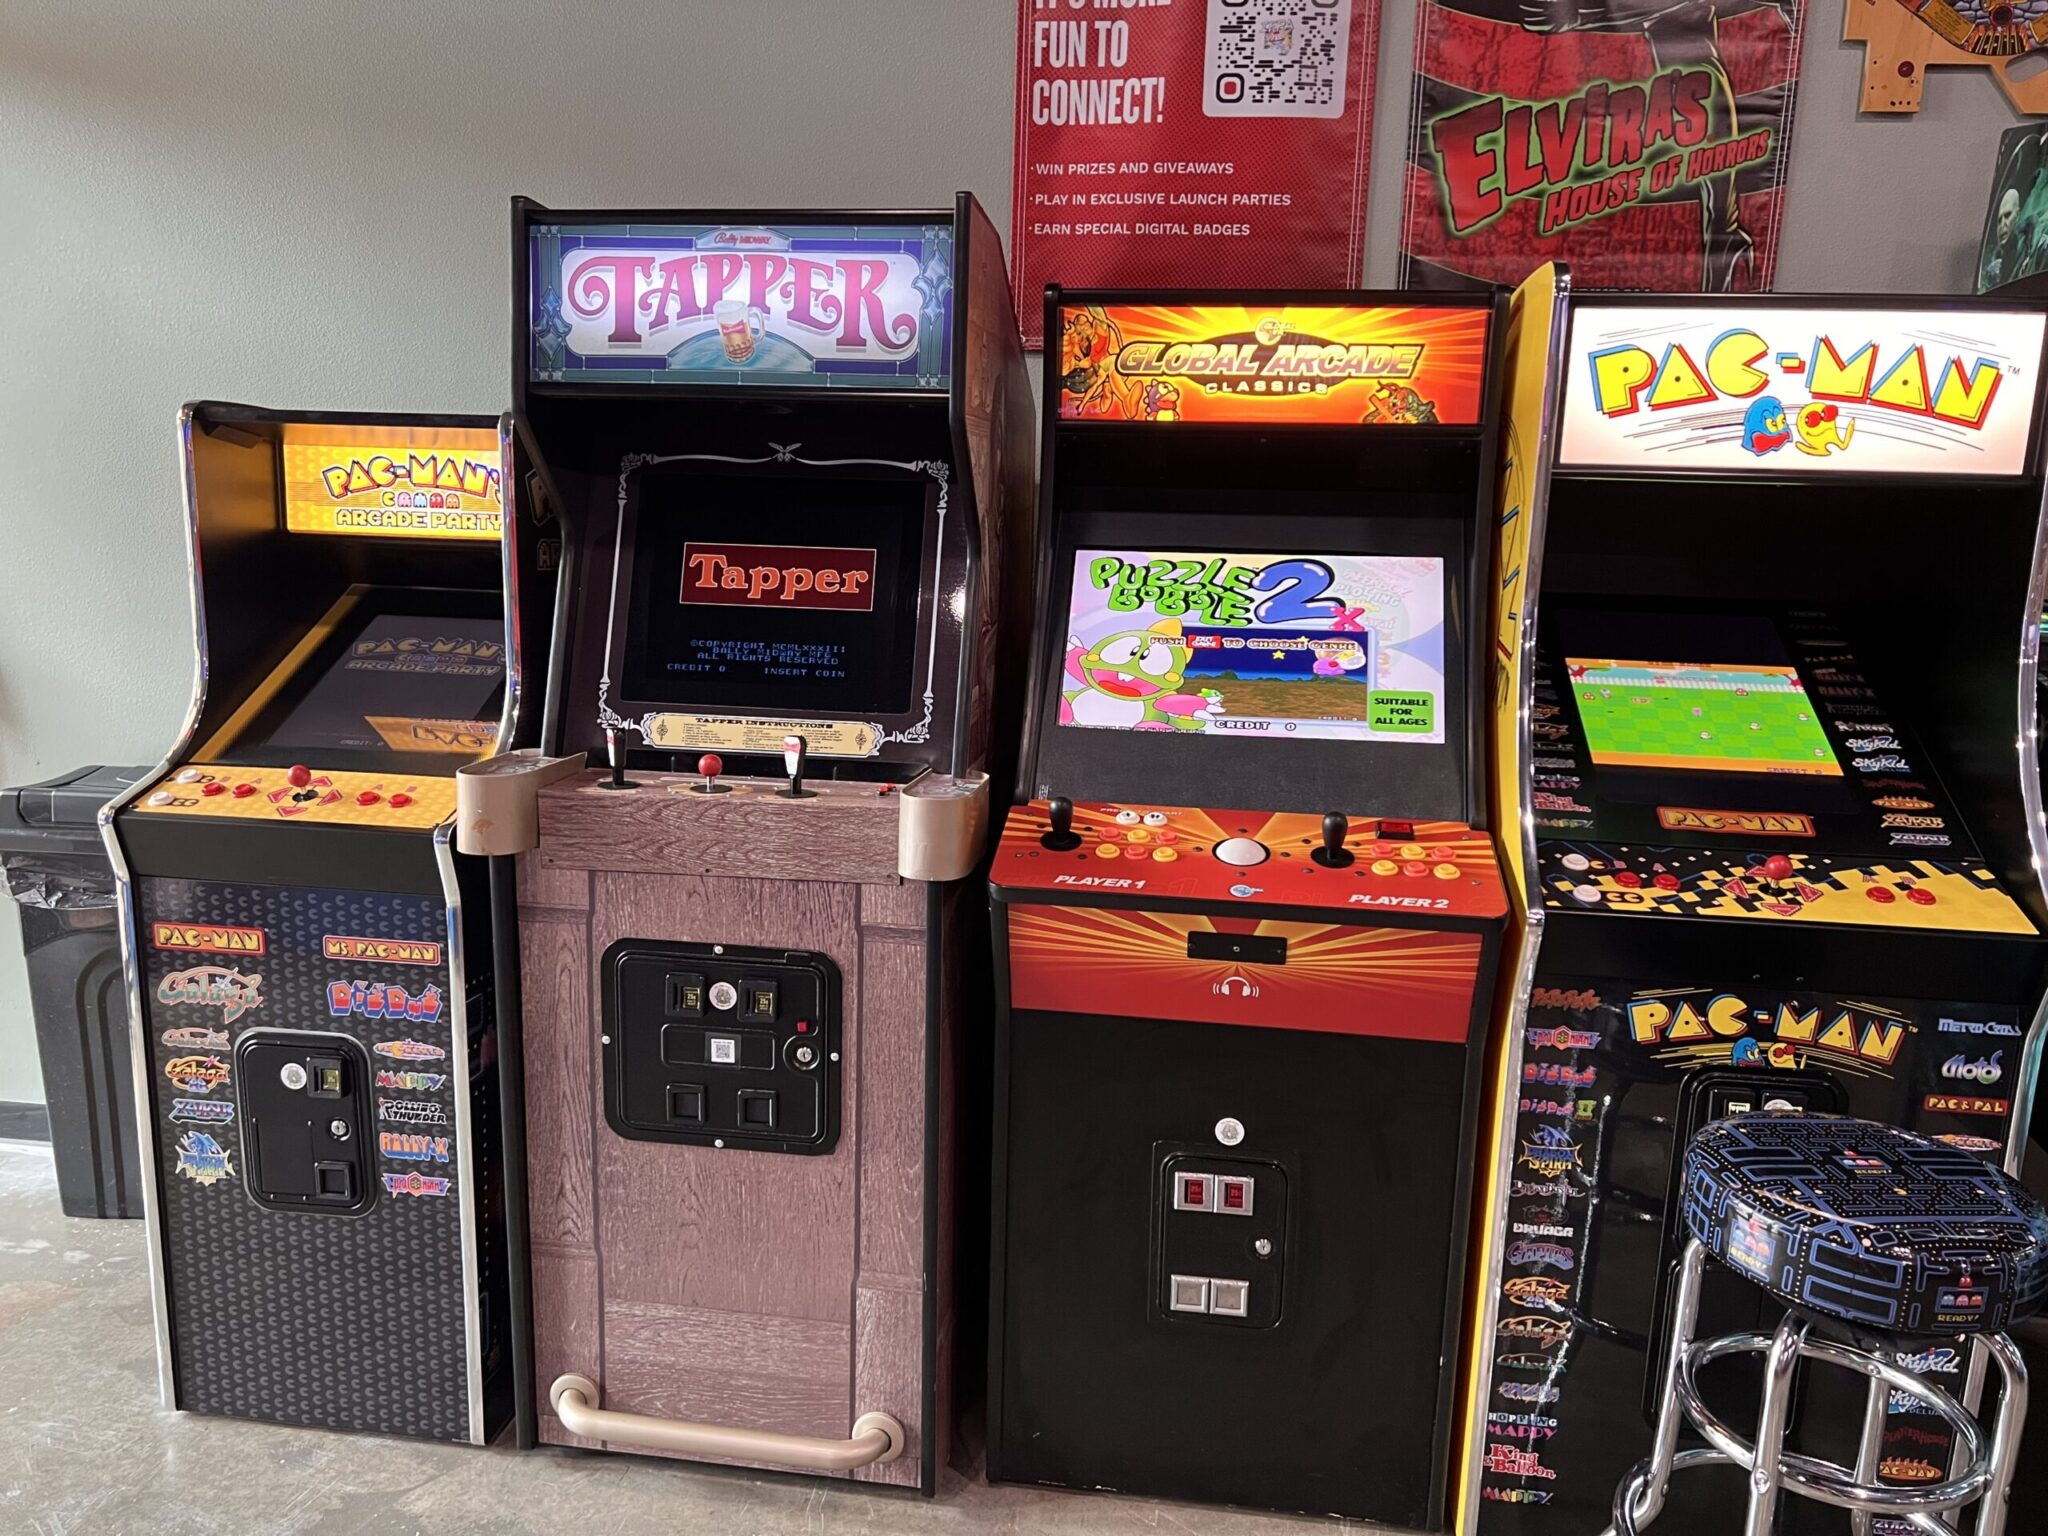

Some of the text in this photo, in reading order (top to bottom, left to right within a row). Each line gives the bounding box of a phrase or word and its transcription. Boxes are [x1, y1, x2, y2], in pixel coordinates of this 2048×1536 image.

[1034, 20, 1128, 67] FUN TO
[1032, 77, 1166, 126] CONNECT!
[1433, 69, 1713, 233] ELVIRA'S
[1036, 162, 1235, 175] WIN PRIZES AND GIVEAWAYS
[1543, 130, 1772, 234] HOUSE OF HORRORS
[1035, 193, 1291, 206] PLAY IN EXCLUSIVE LAUNCH PARTIES
[1034, 223, 1251, 236] EARN SPECIAL DIGITAL BADGES
[567, 253, 918, 350] TAPPER
[1117, 342, 1424, 376] GLOBAL ARCADE
[1204, 381, 1330, 395] CLASSICS
[1588, 327, 2004, 431] PAC-MAN
[336, 508, 502, 532] ARCADE PARTY
[689, 553, 870, 601] Tapper
[1090, 557, 1259, 594] PUZZLE
[1250, 558, 1346, 624] 2
[1108, 583, 1255, 627] BOBBLE
[1150, 636, 1186, 646] PUSH
[1222, 638, 1244, 648] TO
[1247, 639, 1307, 650] CHOOSE
[1309, 641, 1357, 651] GENRE
[697, 652, 839, 665] ALL RIGHTS RESERVED
[345, 660, 501, 676] ARCADE PARTY
[667, 663, 711, 673] CREDIT
[764, 667, 845, 678] INSERT COIN
[1374, 696, 1429, 709] SUITABLE
[1389, 706, 1413, 717] FOR
[695, 717, 834, 729] TAPPER INSTRUCTIONS
[1214, 719, 1271, 731] CREDIT
[1285, 721, 1297, 732] 0
[1375, 716, 1428, 728] ALL AGES
[1664, 810, 1809, 833] PAC-MAN
[1053, 874, 1133, 888] PLAYER
[1134, 877, 1146, 889] 1
[1349, 894, 1449, 909] PLAYER 2
[158, 926, 261, 951] PAC-MAN
[328, 940, 435, 960] MS. PAC-MAN
[1627, 993, 1907, 1066] PAC-MAN
[376, 1070, 447, 1091] MAPPY
[384, 1100, 441, 1118] ROLLING
[1928, 1097, 2004, 1113] PAC & PAL
[392, 1111, 447, 1124] THUNDER
[380, 1132, 450, 1162] RALLY-X
[1512, 1222, 1574, 1238] DRUAGA
[1937, 1313, 1981, 1324] READY!
[1488, 1412, 1558, 1427] HOPPING
[1488, 1423, 1559, 1441] MAPPY
[1490, 1443, 1539, 1466] King
[1491, 1457, 1557, 1479] Balloon
[1481, 1485, 1555, 1505] MAPPY
